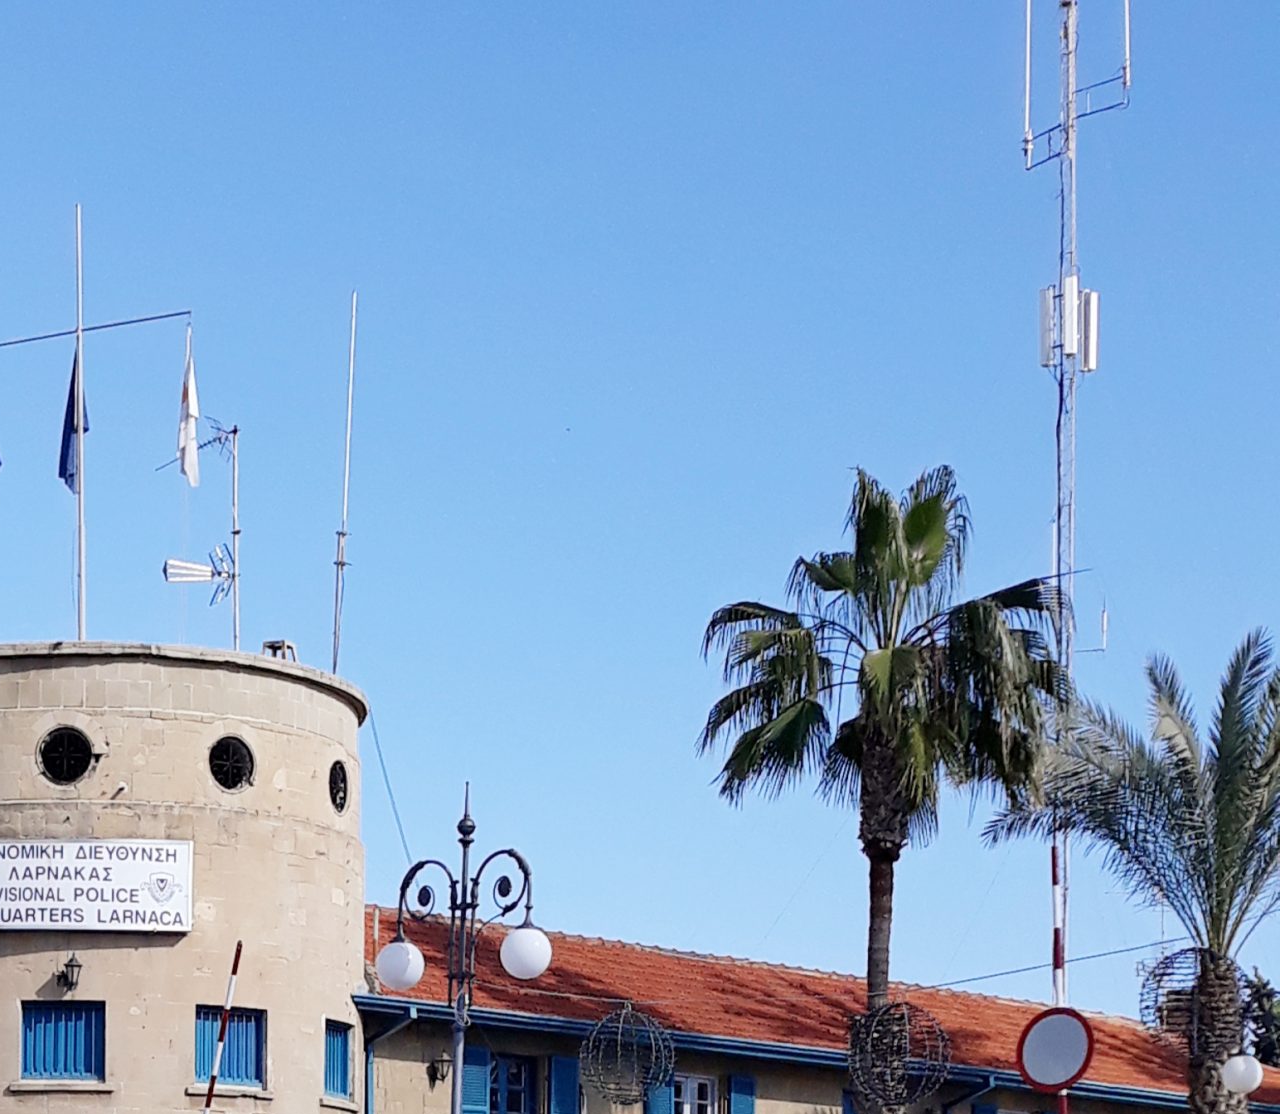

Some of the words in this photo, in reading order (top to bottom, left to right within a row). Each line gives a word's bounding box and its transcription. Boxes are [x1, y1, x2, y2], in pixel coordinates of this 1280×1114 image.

[75, 846, 177, 863] ΔΙΕΥΘΥΝΣΗ
[8, 866, 113, 882] ΛΑΡΝΑΚΑΣ
[74, 888, 140, 904] POLICE
[97, 909, 184, 927] LARNACA
